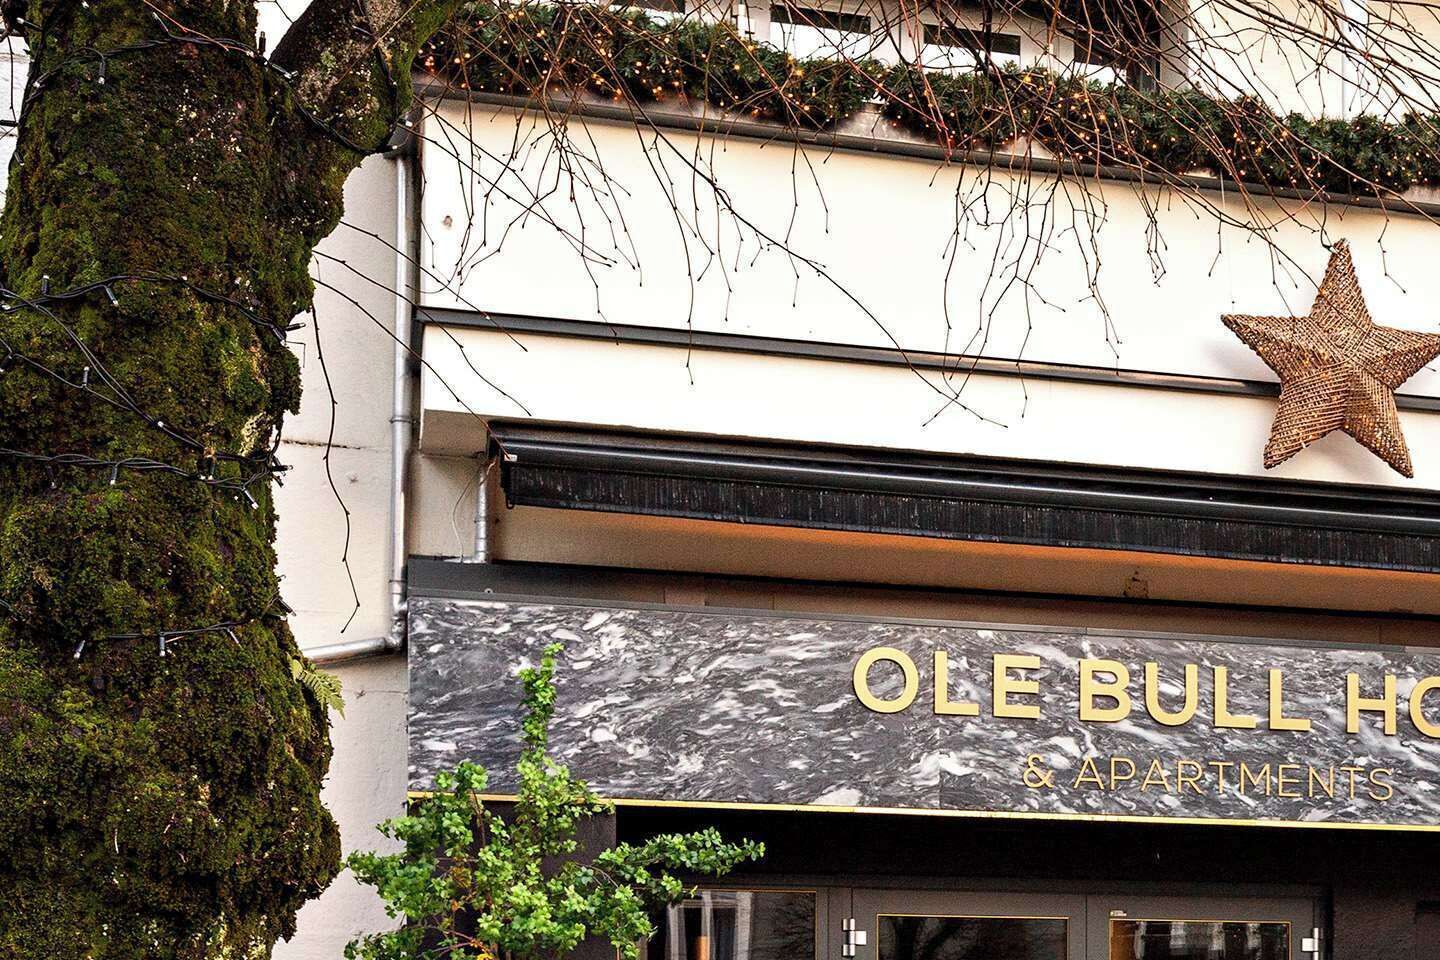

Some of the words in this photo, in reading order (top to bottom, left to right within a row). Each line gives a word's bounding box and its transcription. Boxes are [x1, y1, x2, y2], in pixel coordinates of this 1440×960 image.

[853, 646, 1041, 719] OLE
[1079, 658, 1312, 731] BULL
[1022, 753, 1054, 789] &
[1073, 756, 1394, 801] APARTMENTS
